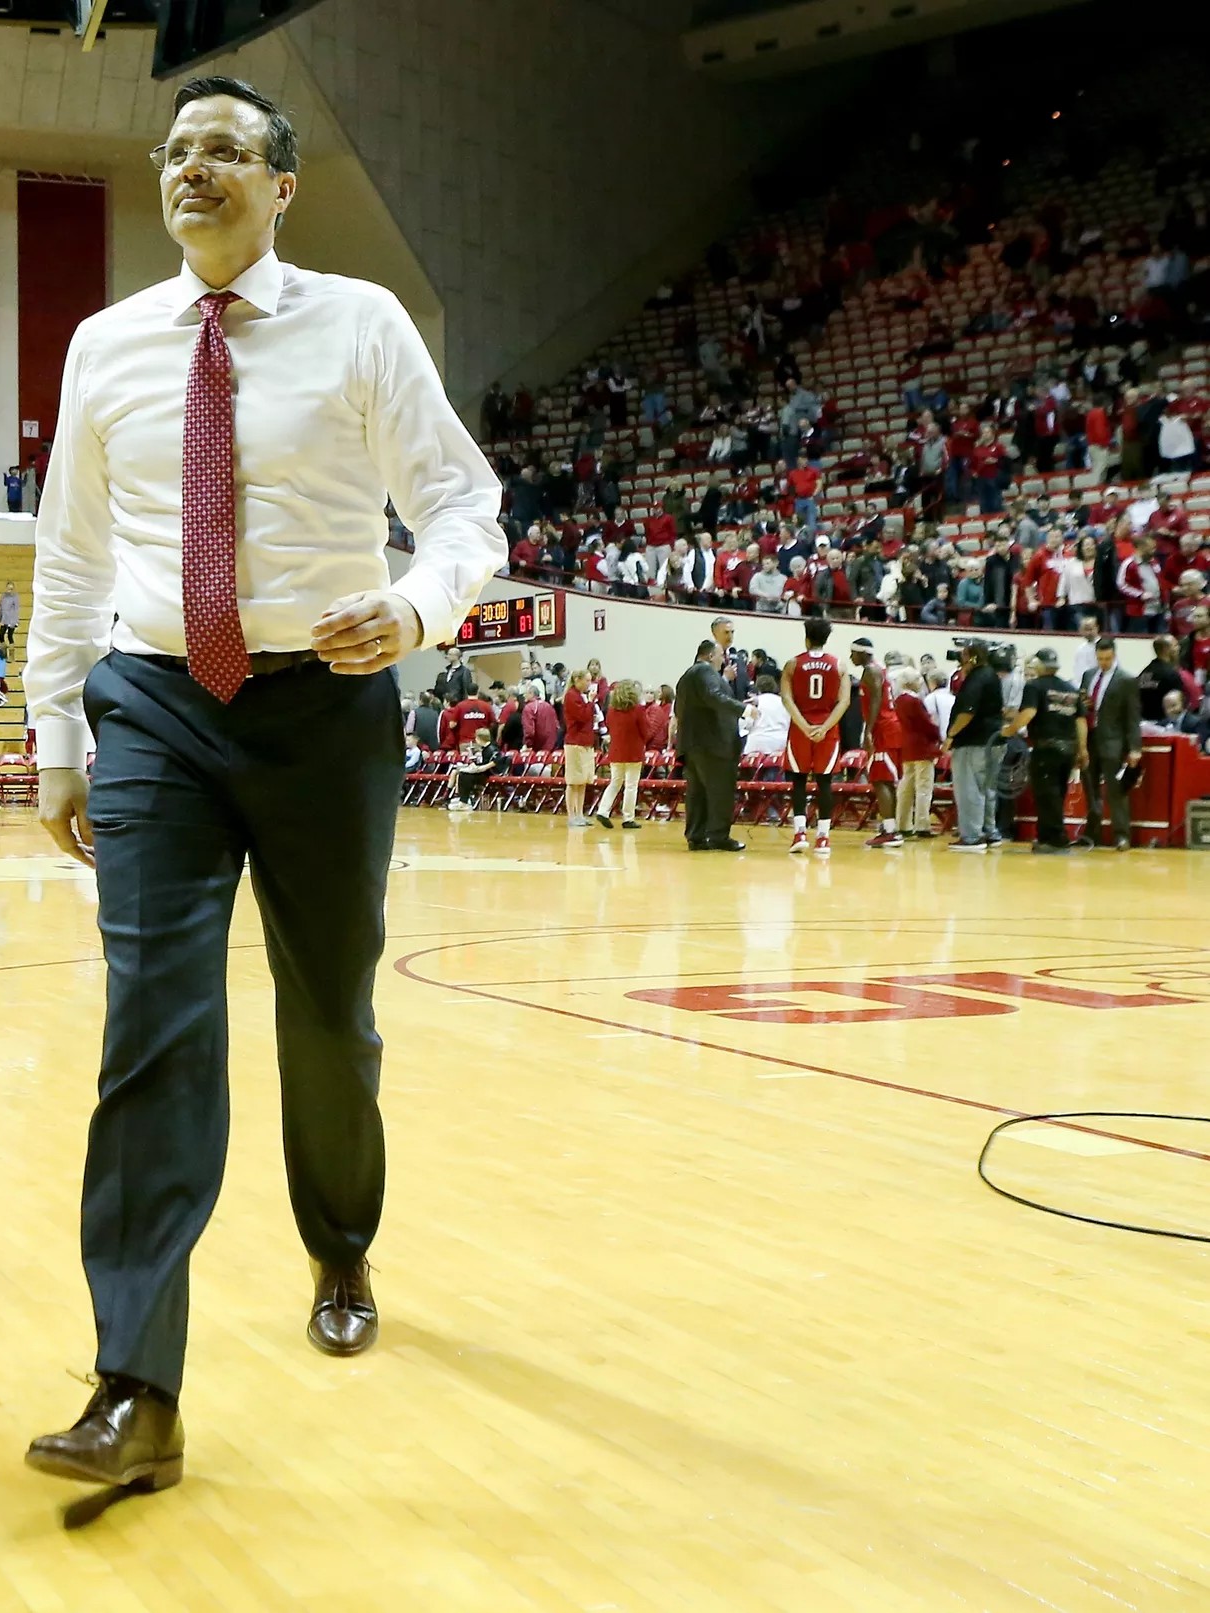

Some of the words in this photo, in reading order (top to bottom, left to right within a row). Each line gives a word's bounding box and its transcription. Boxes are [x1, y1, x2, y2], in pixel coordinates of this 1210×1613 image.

[482, 602, 507, 622] 30:00
[462, 622, 473, 639] 83
[519, 614, 532, 633] 87
[809, 673, 824, 700] 0
[463, 711, 486, 720] adidas
